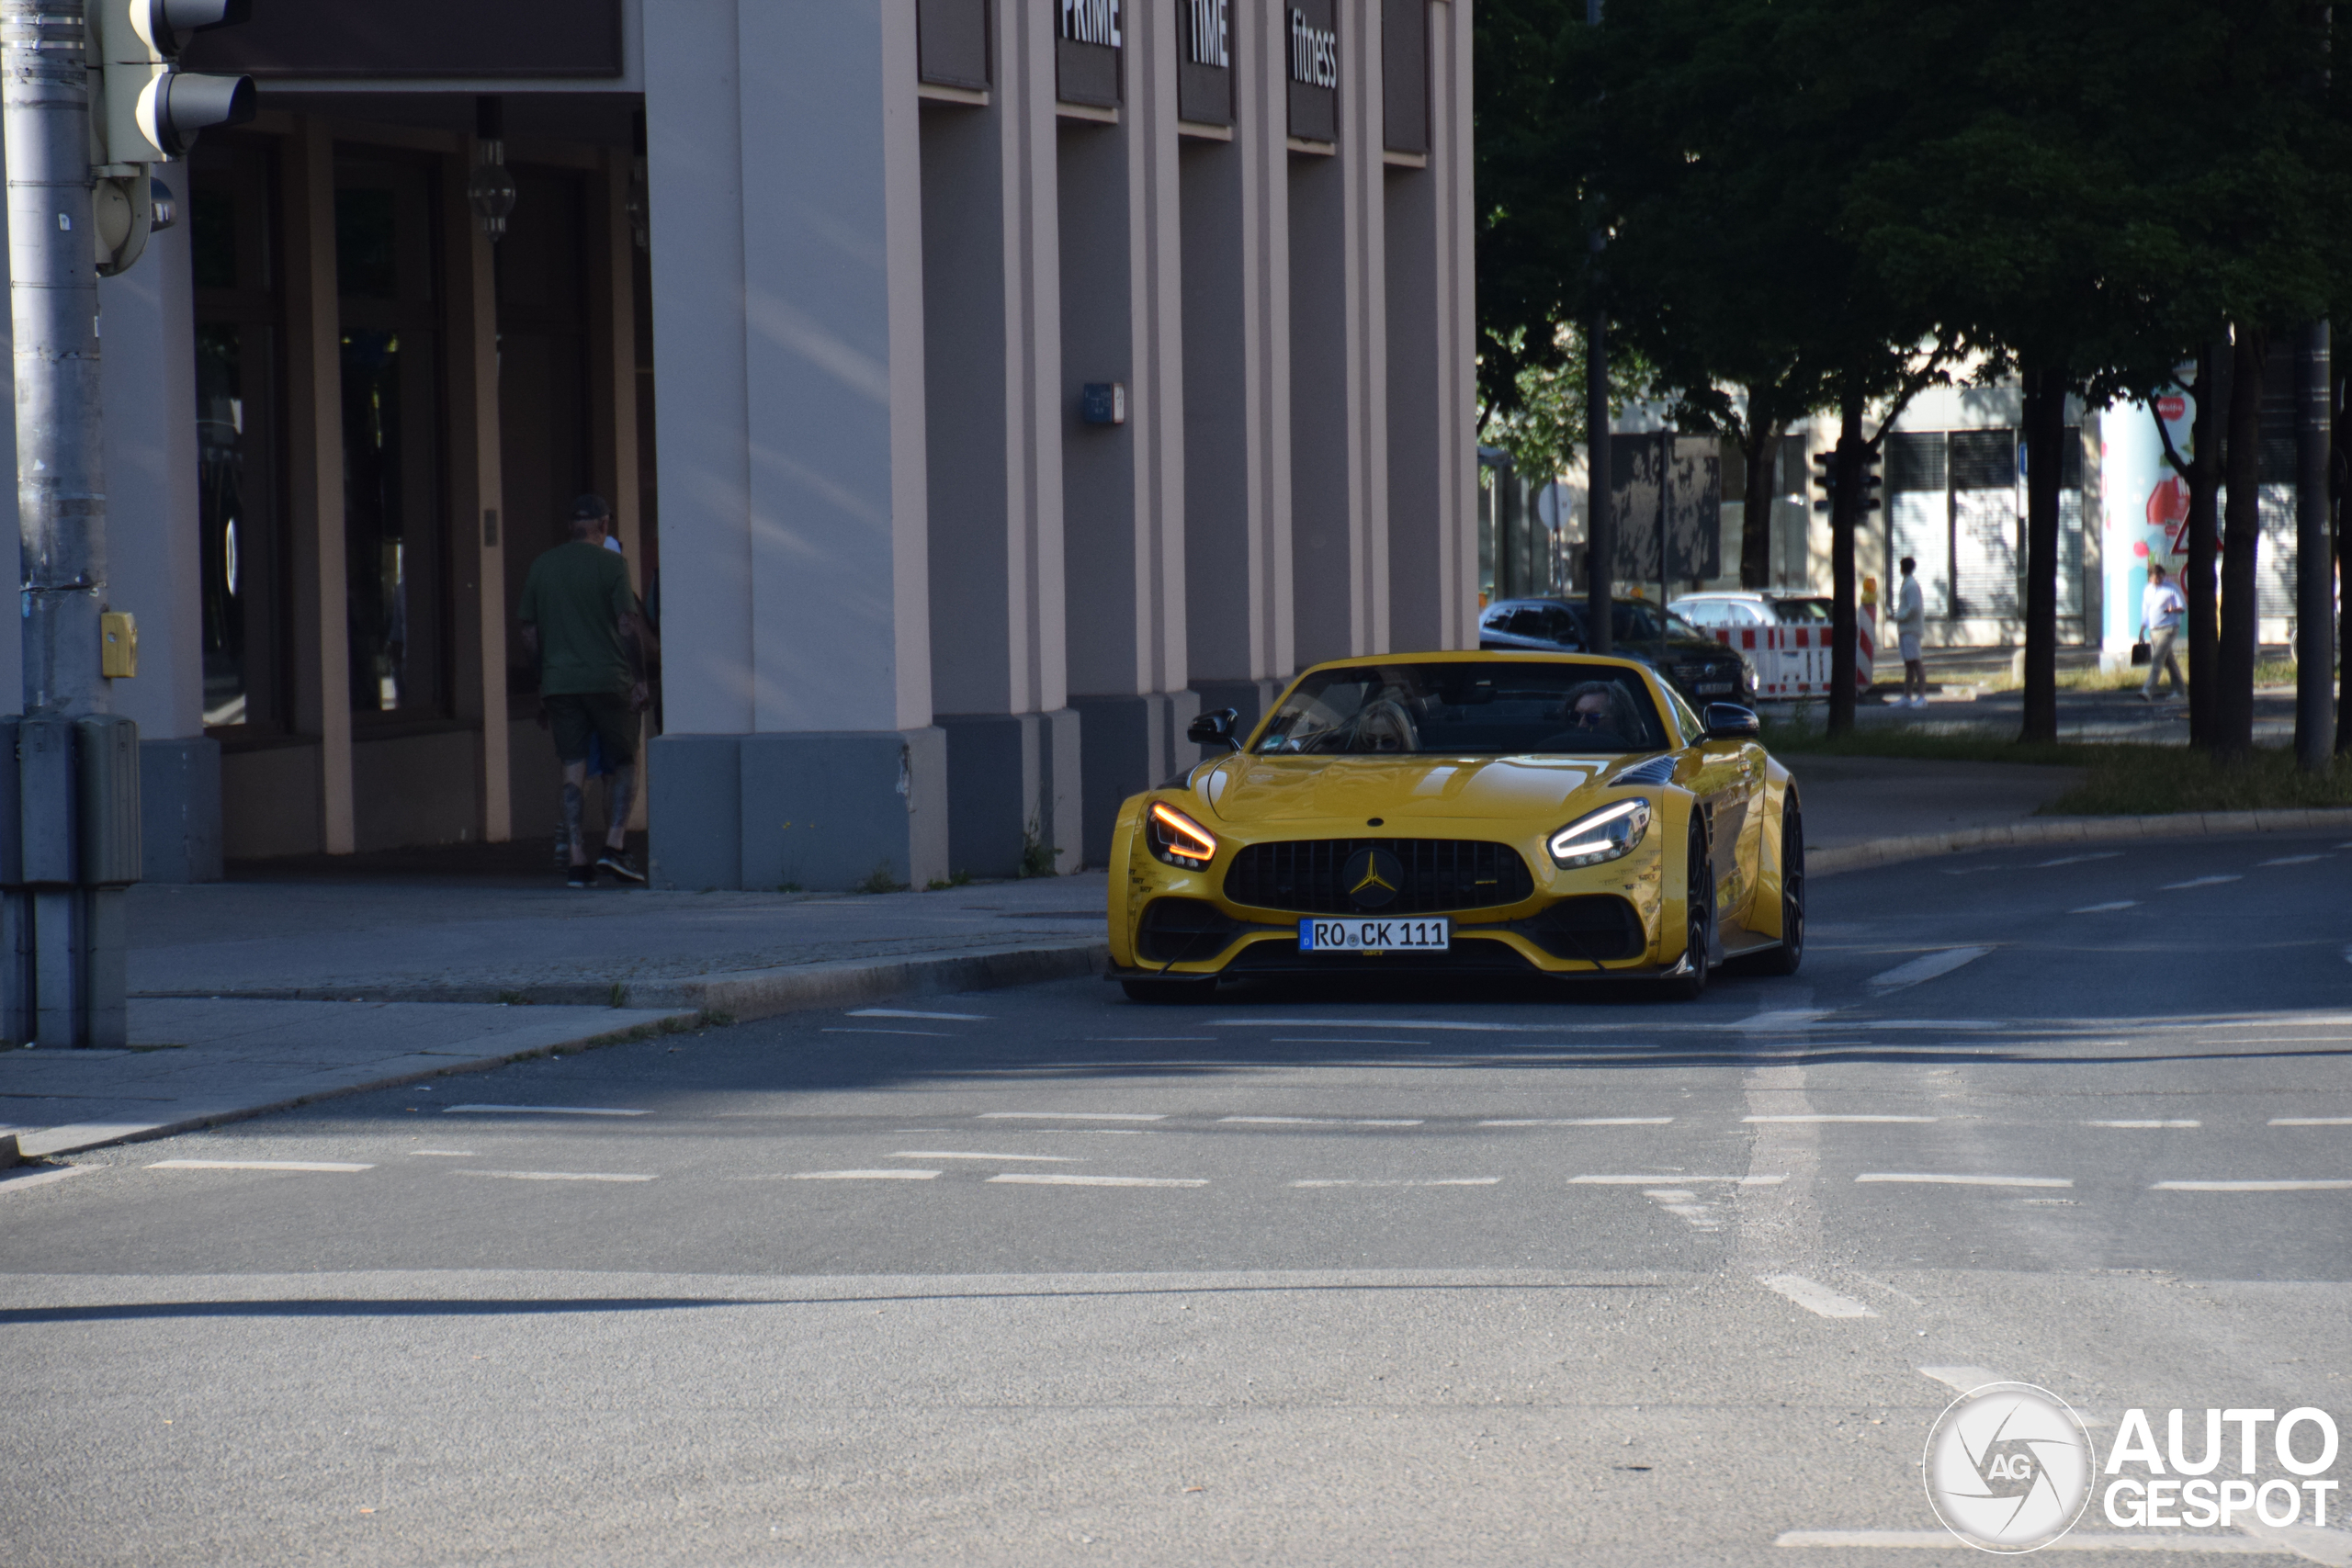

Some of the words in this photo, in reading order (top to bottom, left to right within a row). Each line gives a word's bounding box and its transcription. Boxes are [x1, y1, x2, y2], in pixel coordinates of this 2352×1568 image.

[1062, 0, 1121, 47] PRIME
[1191, 0, 1228, 67] TIME
[1293, 7, 1336, 89] fitness
[1315, 923, 1345, 946] RO
[1362, 923, 1392, 946] CK
[1400, 922, 1445, 946] 111
